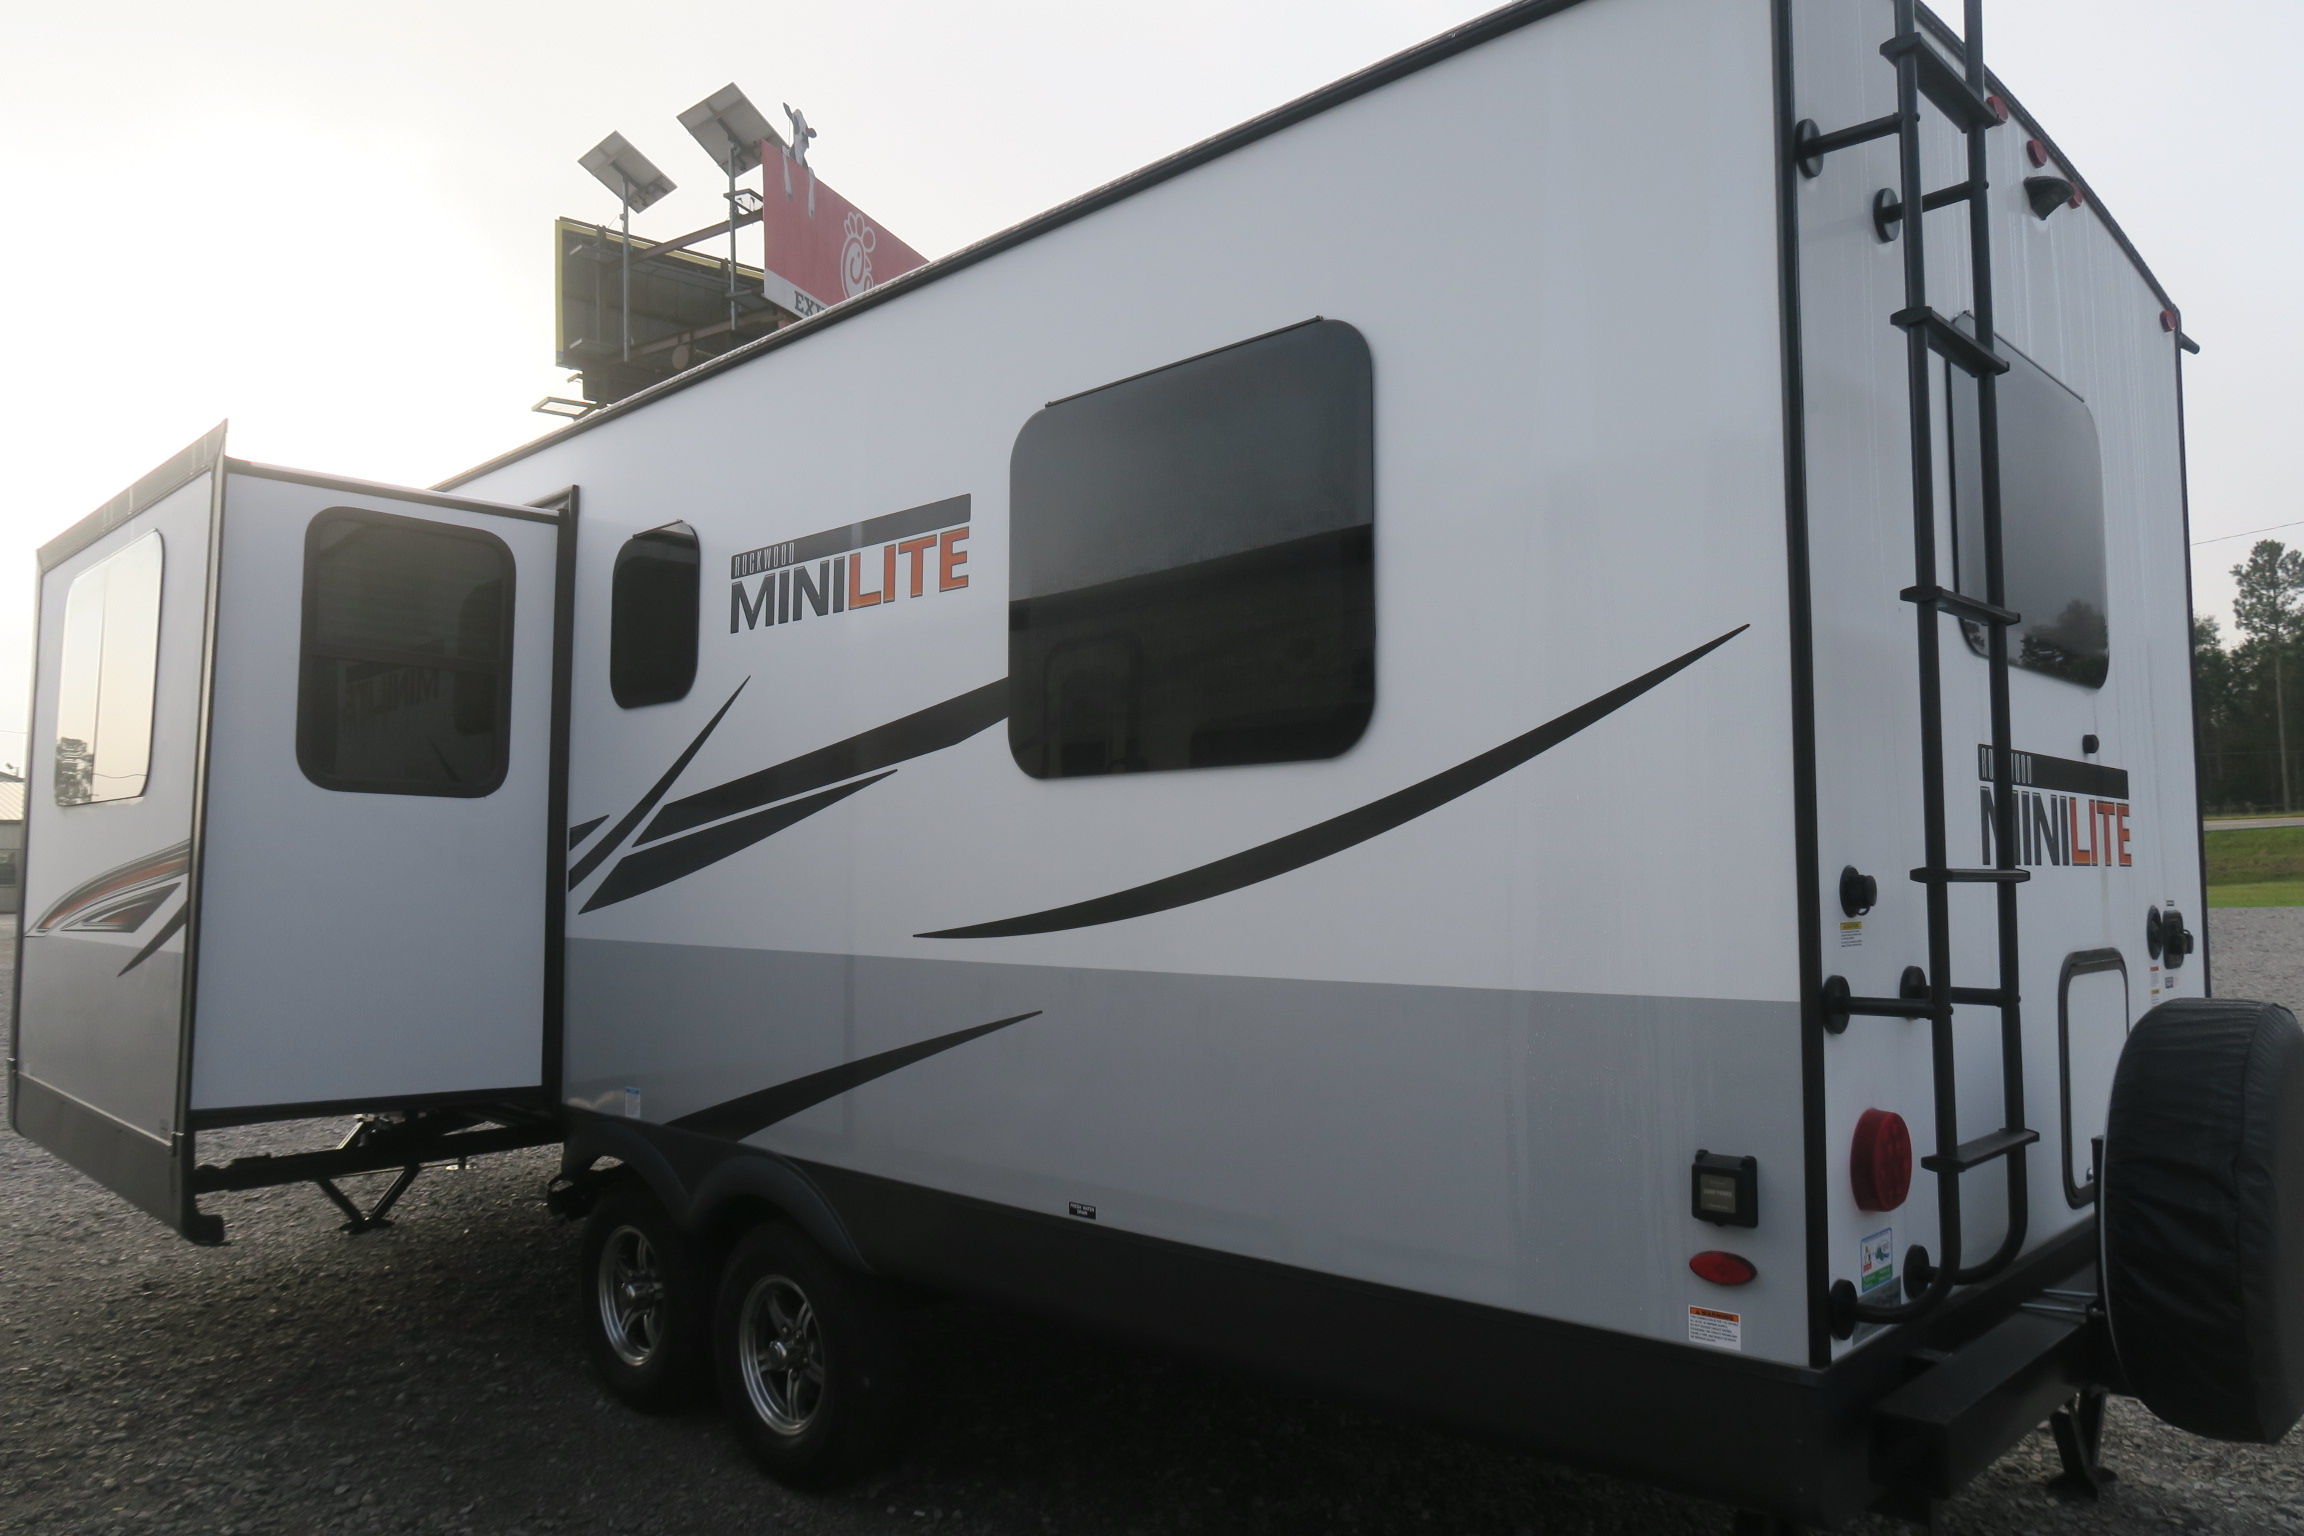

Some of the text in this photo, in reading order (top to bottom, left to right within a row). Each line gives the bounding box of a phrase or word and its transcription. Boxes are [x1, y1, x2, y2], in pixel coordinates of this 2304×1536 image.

[735, 541, 795, 578] ROCKWOOD
[730, 526, 970, 634] MINILITE
[1981, 747, 2032, 784] ROOOD
